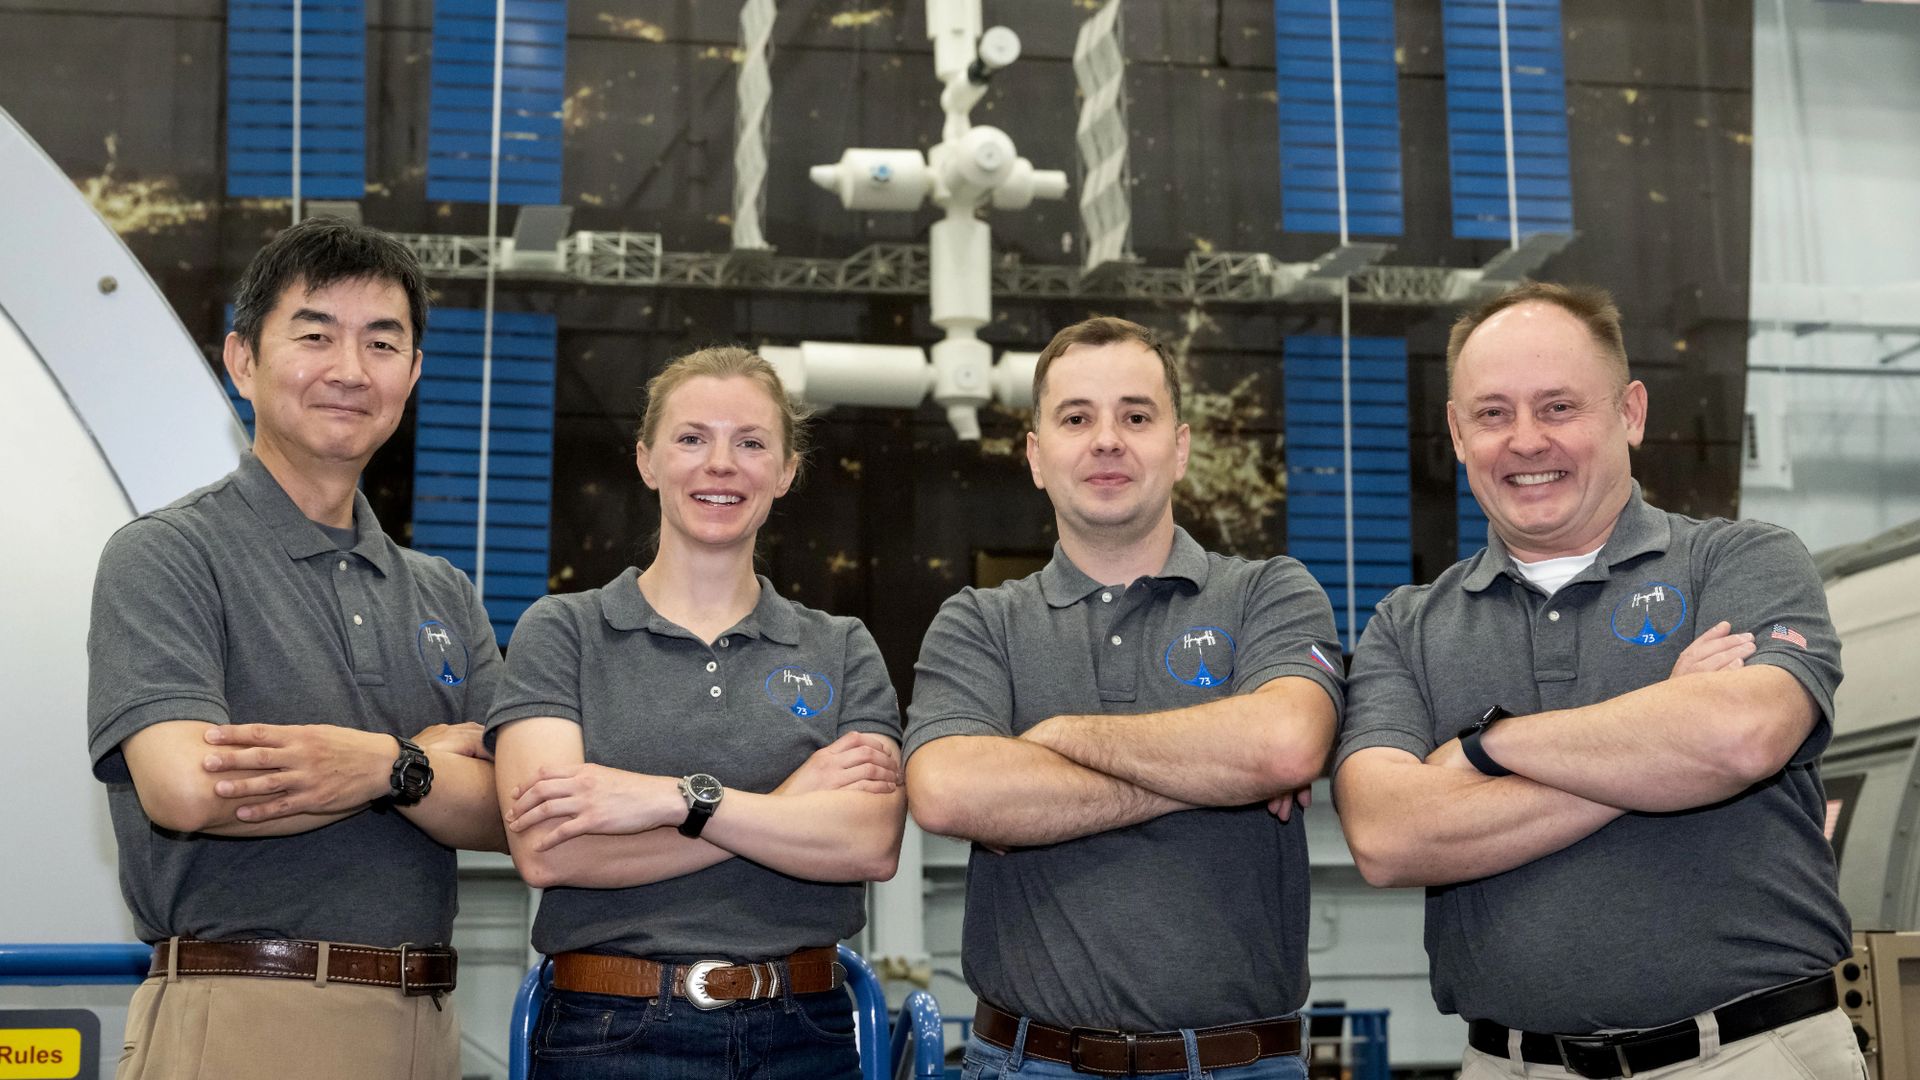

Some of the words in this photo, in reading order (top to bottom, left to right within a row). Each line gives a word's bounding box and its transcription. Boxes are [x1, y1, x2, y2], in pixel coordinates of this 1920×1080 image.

[1642, 633, 1655, 644] 73
[444, 674, 453, 684] 73
[1198, 676, 1211, 686] 73
[796, 706, 808, 716] 73
[0, 1045, 63, 1064] Rules
